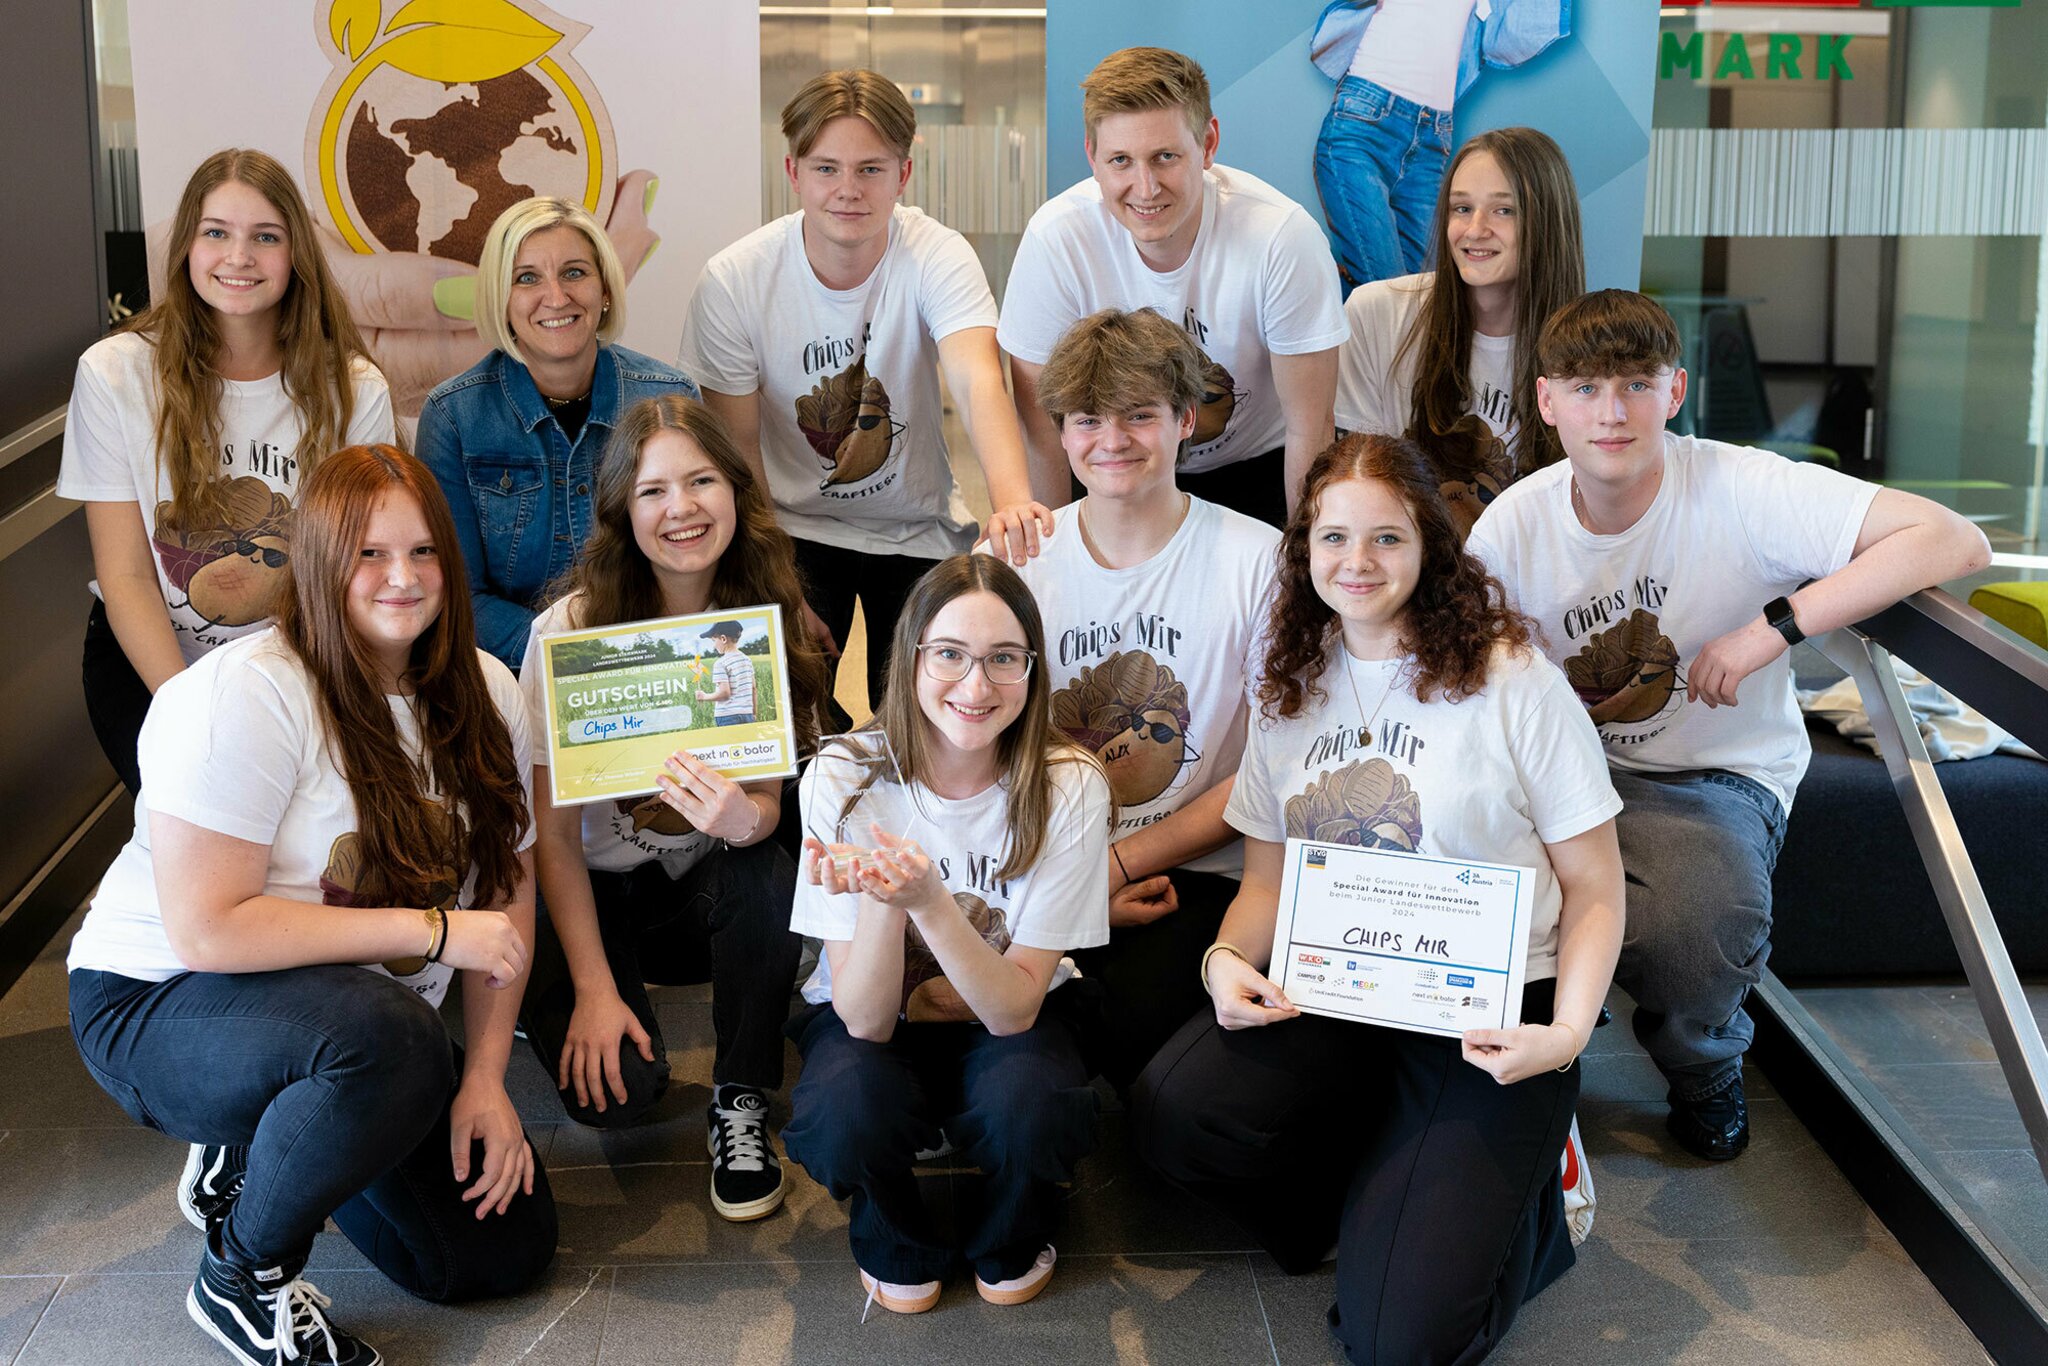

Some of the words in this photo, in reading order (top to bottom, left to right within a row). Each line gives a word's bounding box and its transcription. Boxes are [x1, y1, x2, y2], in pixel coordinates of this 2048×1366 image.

[803, 335, 854, 375] Chips
[249, 439, 297, 486] Mir
[1563, 589, 1626, 640] Chips
[1059, 621, 1121, 667] Chips
[1136, 612, 1182, 658] Mir
[557, 676, 590, 685] SPECIAL
[592, 671, 623, 680] AWARD
[567, 677, 688, 708] GUTSCHEIN
[584, 721, 617, 739] Chips
[623, 716, 644, 730] Mir
[744, 744, 774, 755] bator
[1305, 724, 1372, 770] Chips
[1378, 719, 1425, 767] Mir
[1333, 881, 1369, 891] Special
[1372, 887, 1404, 896] Award
[1407, 890, 1422, 898] für
[1425, 893, 1480, 906] Innovation
[1355, 874, 1371, 882] Die
[1374, 877, 1420, 889] Gewinner
[1441, 886, 1459, 894] den
[1329, 890, 1352, 899] beim
[1356, 894, 1386, 903] Junior
[1390, 898, 1481, 917] Landeswettbewerb
[1392, 908, 1415, 917] 2024
[1343, 927, 1403, 952] CHIPS
[1415, 935, 1449, 958] MIR
